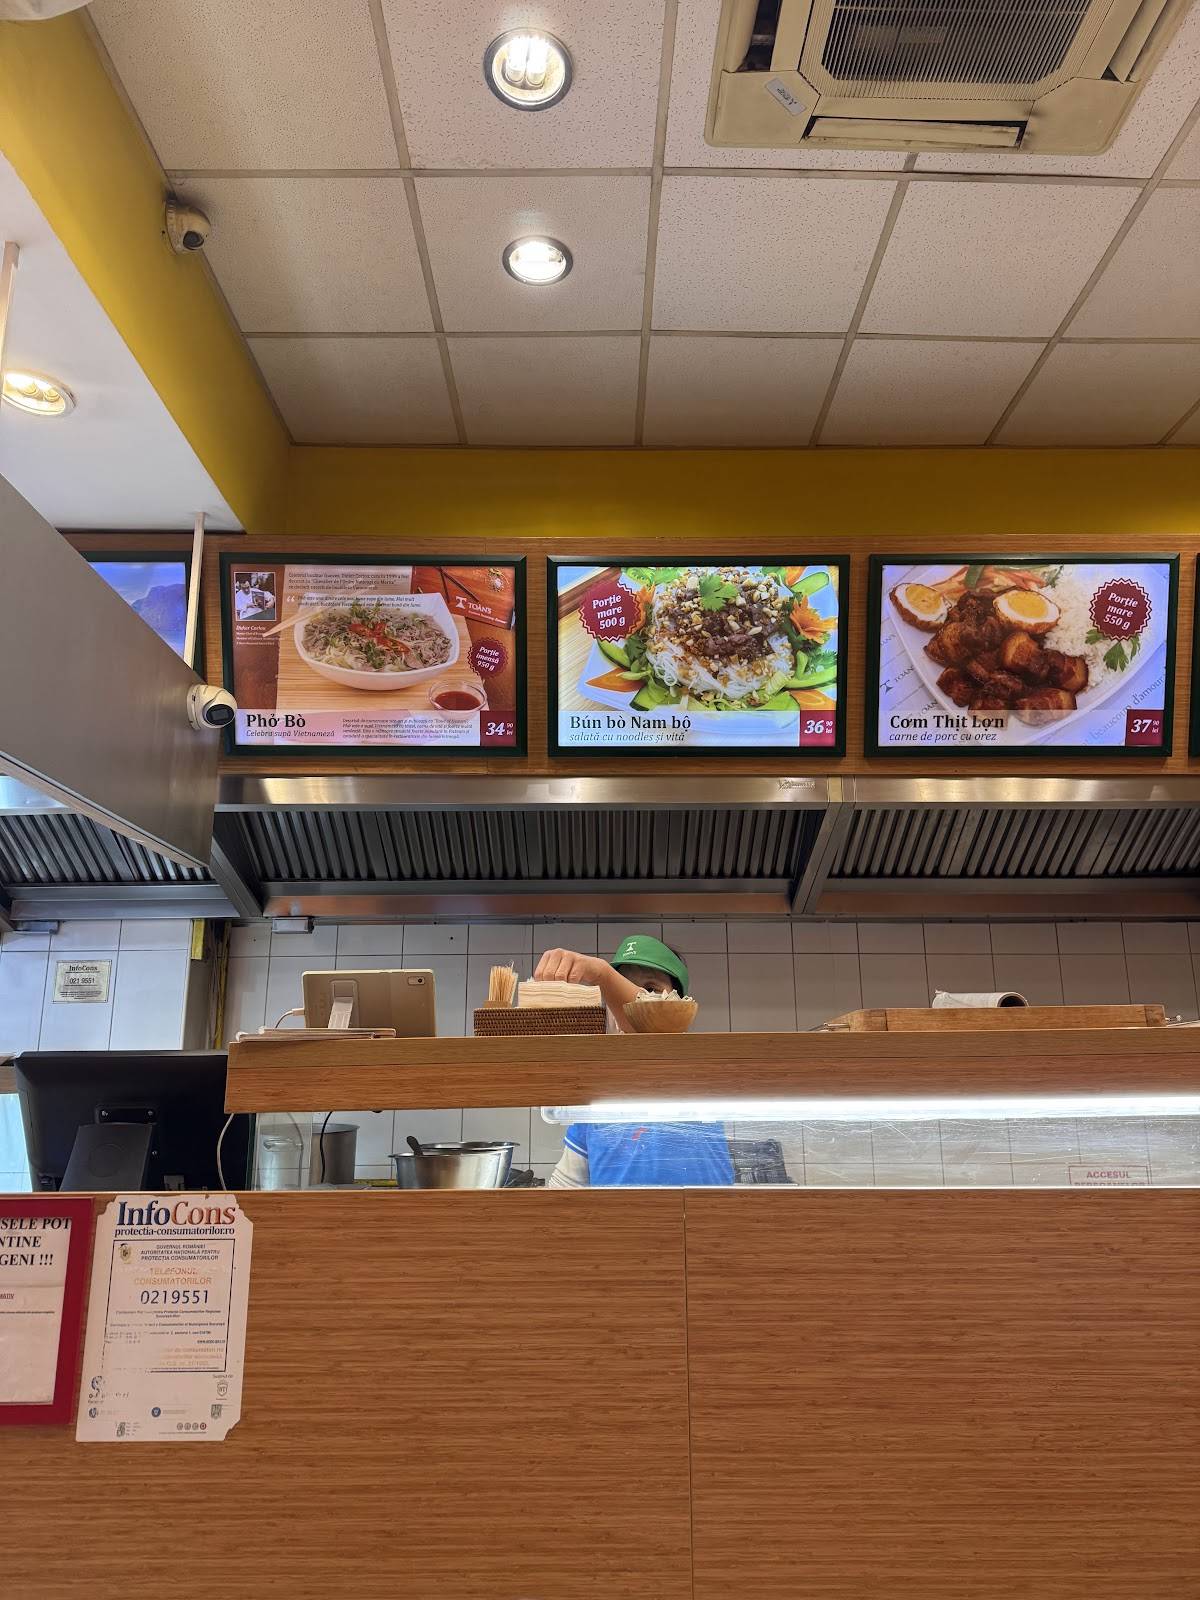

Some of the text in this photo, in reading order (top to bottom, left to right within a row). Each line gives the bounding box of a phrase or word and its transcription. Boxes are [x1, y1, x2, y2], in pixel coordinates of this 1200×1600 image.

[592, 594, 622, 609] Porție
[1108, 592, 1138, 608] Porție
[597, 606, 623, 619] mare
[1106, 605, 1134, 618] mare
[600, 616, 626, 630] 500 g
[1103, 614, 1131, 630] 550 g
[479, 646, 500, 656] Porție
[475, 652, 500, 664] imensă
[477, 660, 490, 669] 950
[246, 713, 306, 728] Phở Bò
[506, 721, 514, 729] 90
[570, 715, 692, 732] Bún bò Nam bộ
[804, 719, 825, 734] 36
[890, 715, 1005, 731] Cơm Thịt Lợn
[1130, 719, 1153, 733] 37
[274, 729, 291, 738] supă
[293, 729, 335, 737] Vietnameză
[485, 721, 506, 736] 34
[569, 732, 600, 741] salată
[616, 732, 653, 741] noodles
[666, 732, 685, 741] vită
[889, 731, 998, 743] carne de porc cu orez
[1086, 1170, 1132, 1179] ACCESUL
[116, 1200, 236, 1226] InfoCons
[0, 1218, 71, 1230] SELE POT
[114, 1226, 235, 1238] protectia-consumatorilor.ro
[0, 1254, 54, 1266] GENI !!!
[134, 1277, 212, 1286] CONSUMATORILOR
[140, 1289, 209, 1304] 0219551
